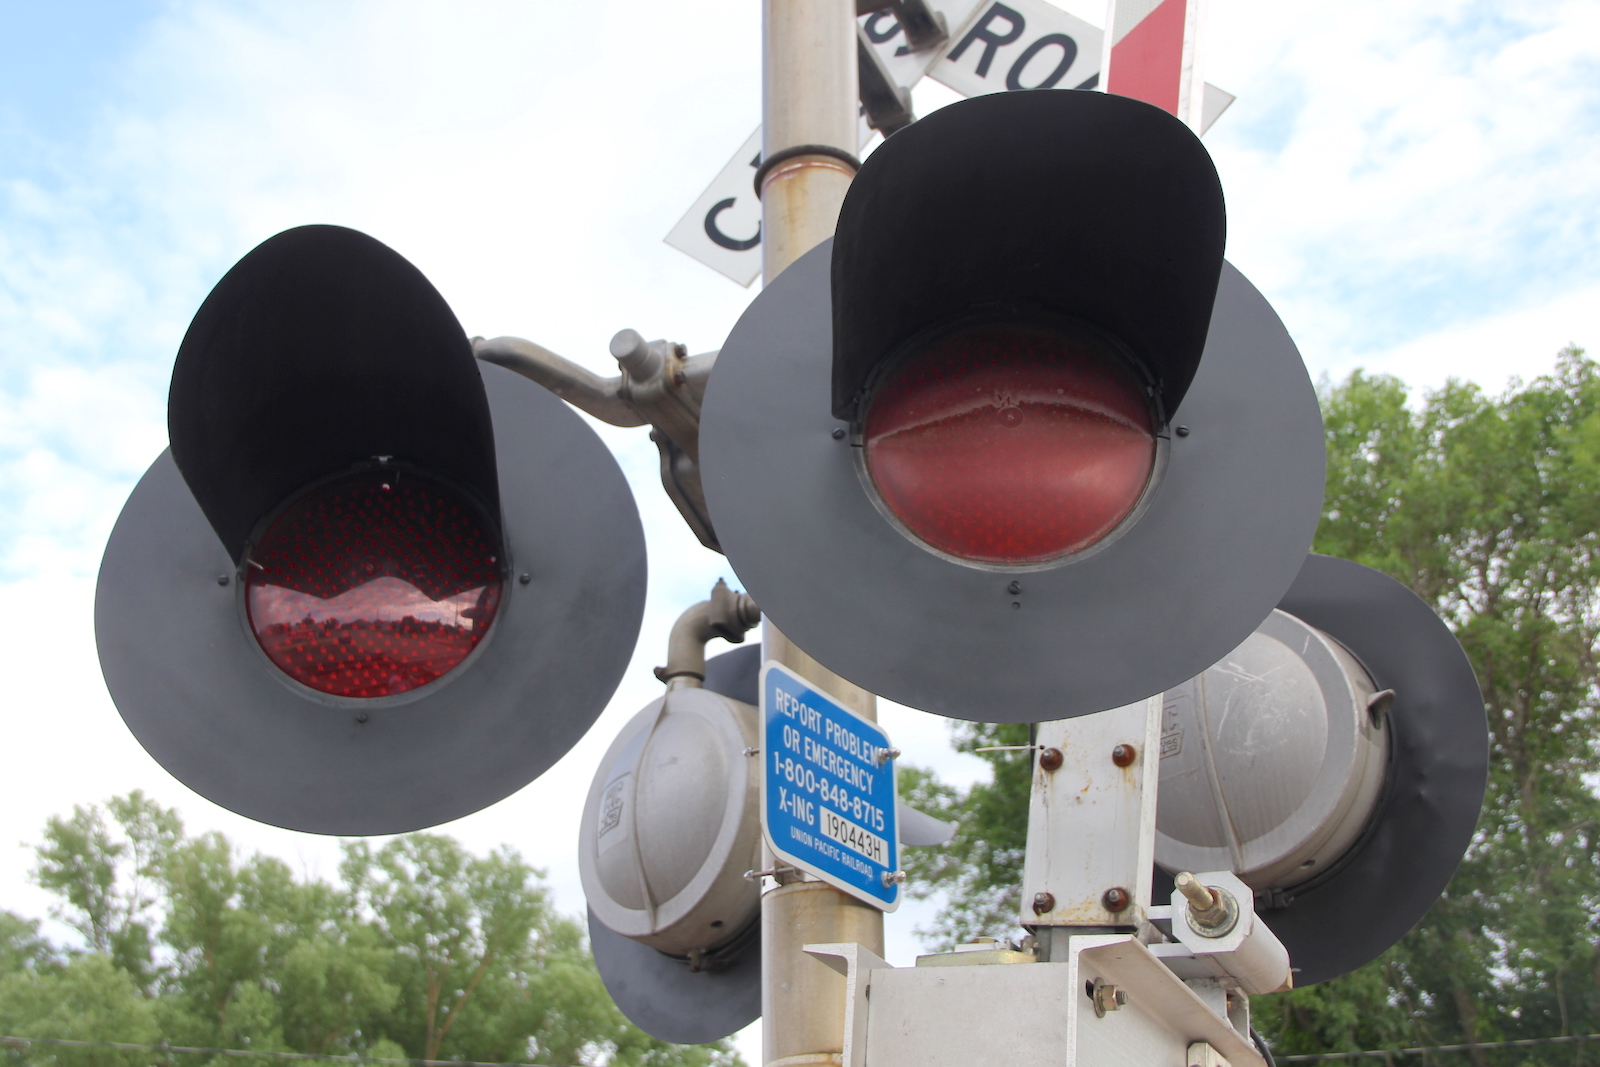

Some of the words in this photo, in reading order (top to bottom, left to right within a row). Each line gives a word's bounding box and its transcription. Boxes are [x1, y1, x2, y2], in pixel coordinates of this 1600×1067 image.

[946, 1, 1100, 91] RO
[775, 687, 822, 735] REPORT
[825, 717, 879, 769] PROBLEM
[783, 724, 801, 754] OR
[804, 735, 874, 796] EMERGENCY
[774, 751, 885, 832] 1-800-848-8715
[779, 785, 815, 826] X-ING
[827, 813, 881, 862] 190443H
[790, 825, 813, 848] UNION
[814, 837, 841, 862] PACIFIC
[841, 851, 874, 879] RAILROAD
